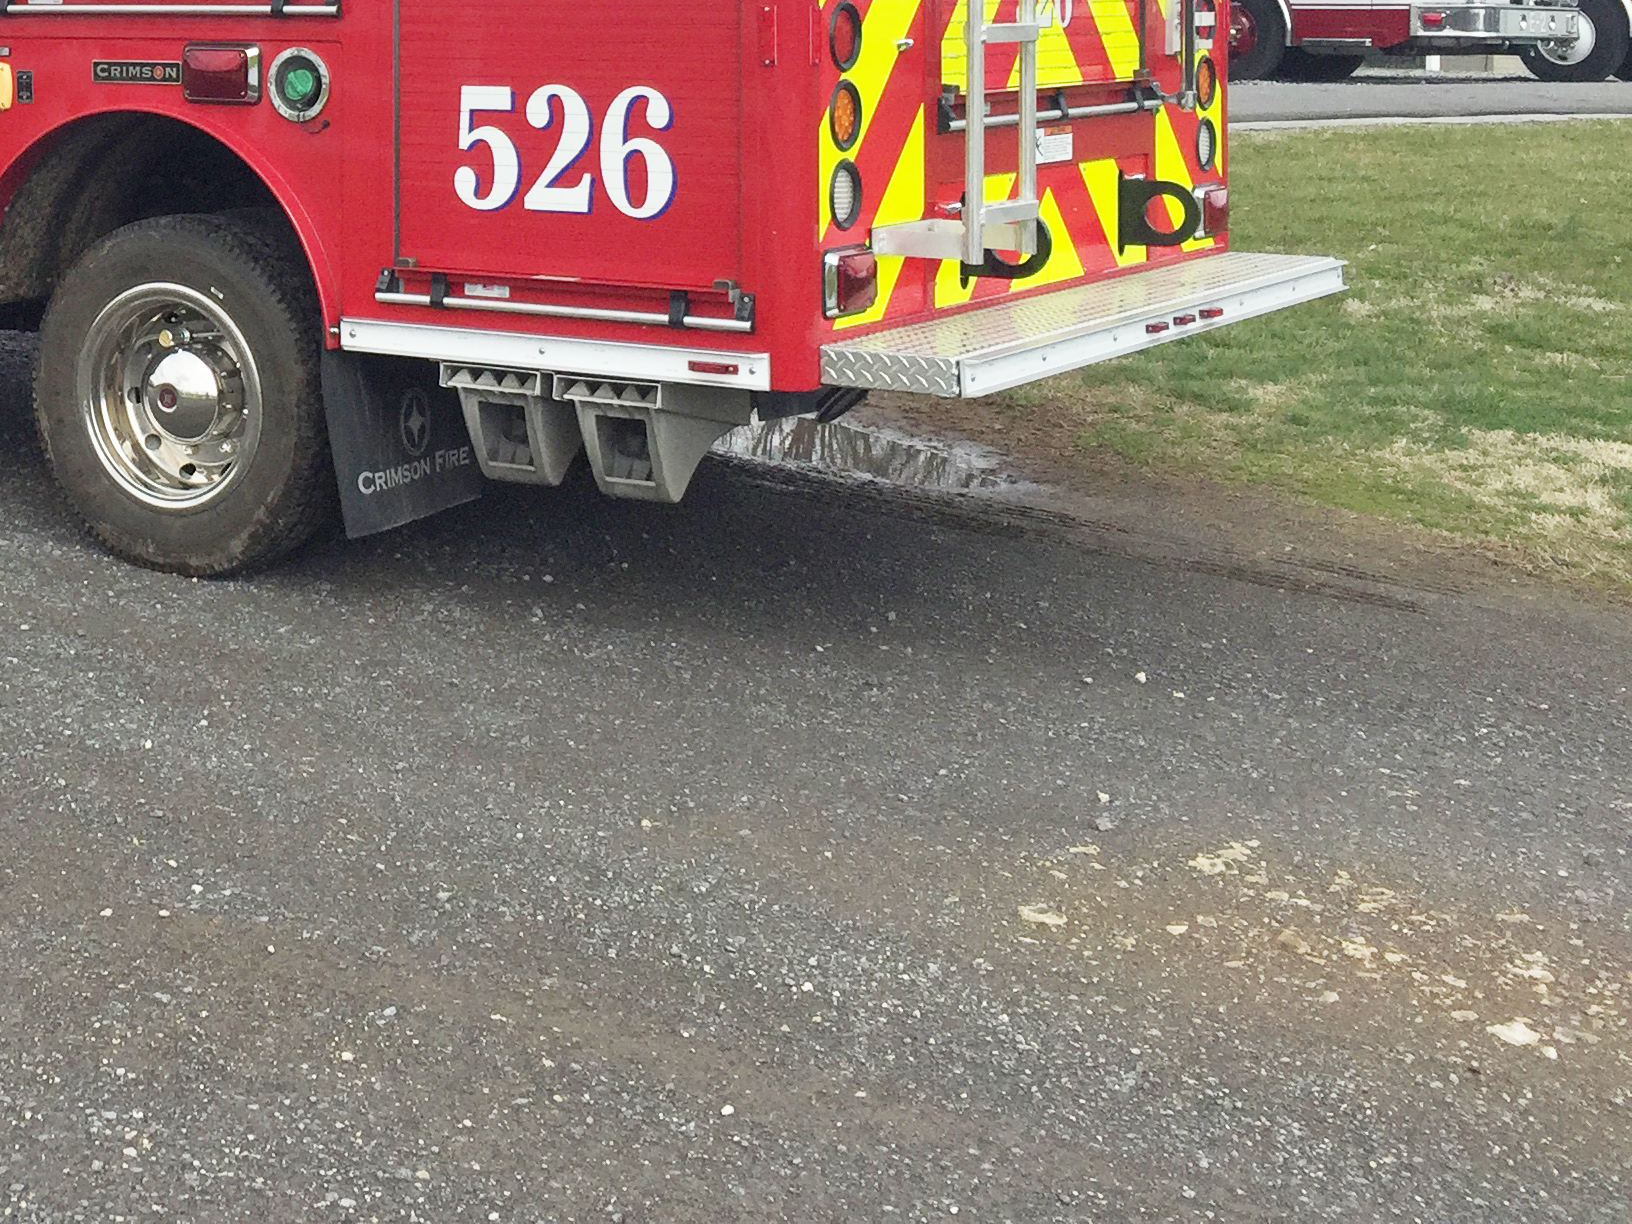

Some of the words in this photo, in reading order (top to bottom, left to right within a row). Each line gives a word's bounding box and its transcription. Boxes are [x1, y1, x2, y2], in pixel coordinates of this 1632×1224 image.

[96, 64, 177, 80] CRIMSON
[453, 83, 679, 221] 526
[357, 457, 430, 495] CRIMSON
[434, 446, 470, 473] FIRE
